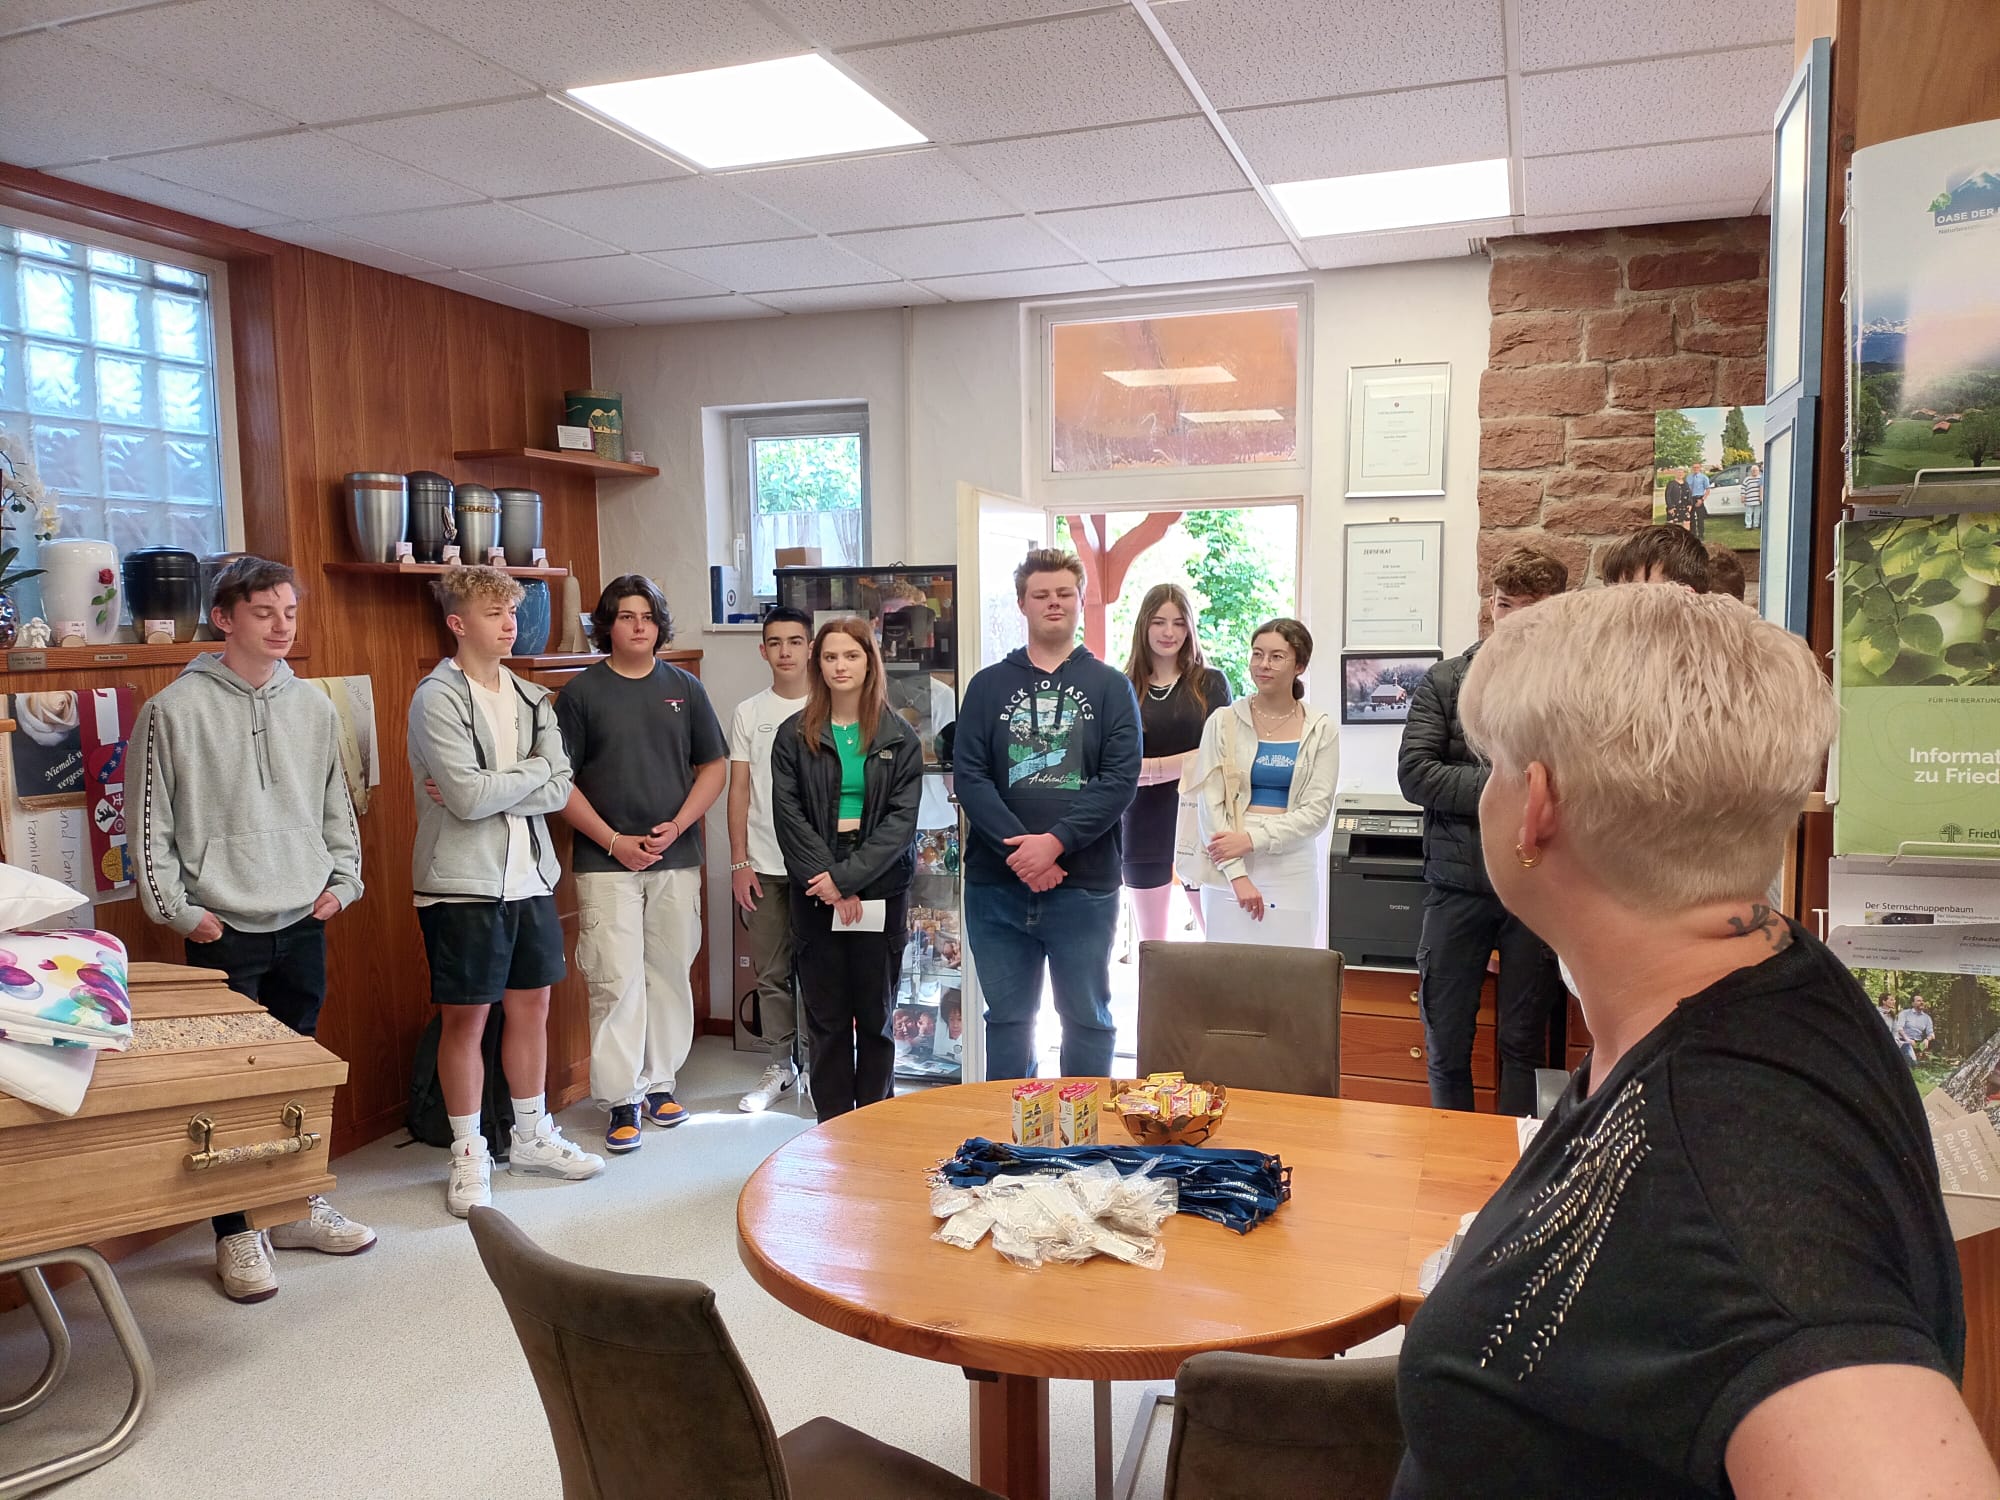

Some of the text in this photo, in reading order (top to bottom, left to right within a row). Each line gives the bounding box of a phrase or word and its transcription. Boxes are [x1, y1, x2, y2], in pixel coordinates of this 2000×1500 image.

[1936, 208, 1995, 224] OASE DER
[1000, 688, 1029, 721] BACK
[44, 753, 76, 782] Niemals
[1914, 766, 2000, 785] zu Fried
[59, 810, 78, 840] und
[1968, 828, 2000, 839] Fried
[1865, 901, 1974, 913] Der Sternschnuppenbaum
[1943, 1132, 1962, 1162] Ruhe
[1958, 1164, 1969, 1176] in
[1957, 1128, 1972, 1148] Die
[1967, 1149, 1989, 1182] letzte
